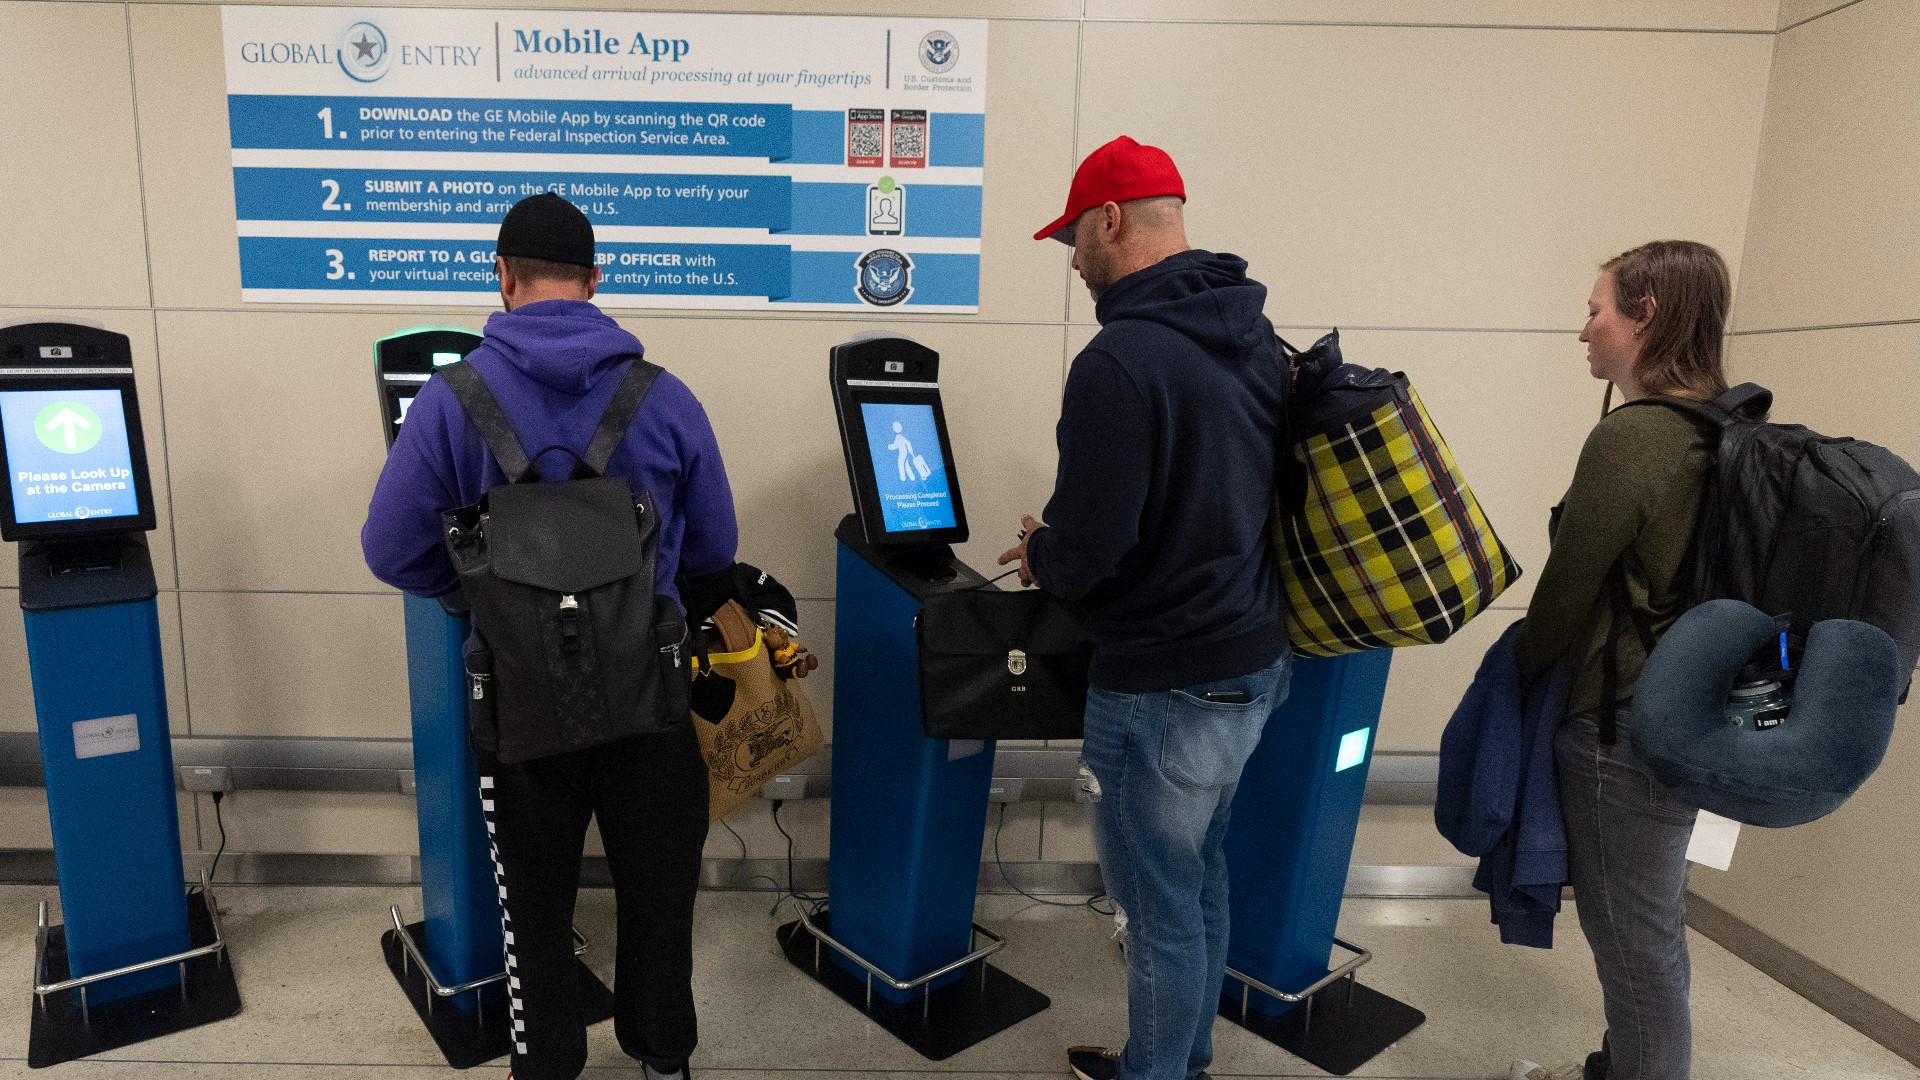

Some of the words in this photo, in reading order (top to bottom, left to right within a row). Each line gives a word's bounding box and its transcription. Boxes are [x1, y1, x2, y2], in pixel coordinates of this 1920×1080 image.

[513, 28, 620, 54] Mobile
[628, 31, 690, 62] App
[241, 42, 333, 64] GLOBAL
[401, 45, 481, 66] ENTRY
[514, 65, 588, 80] advanced
[592, 66, 647, 81] arrival
[651, 68, 732, 86] processing
[737, 70, 752, 83] at
[756, 73, 793, 86] your
[794, 70, 871, 86] fingertips
[920, 75, 954, 83] Customs
[933, 84, 972, 92] Protection
[317, 107, 347, 139] 1.
[359, 107, 452, 121] DOWNLOAD
[457, 109, 480, 122] the
[484, 110, 503, 123] GE
[508, 110, 556, 124] Mobile
[561, 111, 590, 126] App
[594, 111, 611, 127] by
[614, 112, 676, 129] scanning
[681, 113, 703, 126] the
[708, 114, 728, 128] QR
[732, 114, 766, 128] code
[361, 126, 394, 141] prior
[400, 128, 415, 140] to
[418, 128, 477, 144] entering
[482, 129, 505, 141] the
[510, 129, 560, 142] Federal
[565, 129, 636, 145] Inspection
[641, 131, 688, 144] Service
[693, 132, 729, 146] Area.
[321, 179, 351, 211] 2.
[365, 180, 422, 194] SUBMIT
[427, 181, 439, 194] A
[443, 182, 494, 195] PHOTO
[498, 185, 516, 196] on
[521, 182, 543, 196] the
[548, 183, 566, 196] GE
[571, 183, 619, 197] Mobile
[623, 185, 651, 200] App
[656, 186, 671, 198] to
[675, 186, 714, 201] verify
[718, 188, 750, 201] your
[366, 198, 451, 215] membership
[456, 200, 481, 213] and
[593, 202, 619, 215] U.S.
[369, 250, 424, 263] REPORT
[429, 251, 449, 263] TO
[454, 251, 466, 263] A
[620, 253, 681, 267] OFFICER
[685, 254, 716, 267] with
[325, 249, 356, 280] 3.
[370, 271, 401, 283] your
[405, 268, 449, 281] virtual
[614, 272, 650, 287] entry
[655, 272, 682, 284] into
[686, 273, 708, 285] the
[713, 273, 739, 285] U.S.
[18, 471, 67, 482] Please
[71, 468, 107, 480] Look
[110, 467, 130, 480] Up
[27, 485, 41, 495] at
[44, 484, 68, 494] the
[72, 481, 126, 492] Camera
[918, 491, 946, 499] Completed
[1758, 719, 1762, 727] I
[1763, 719, 1778, 727] am
